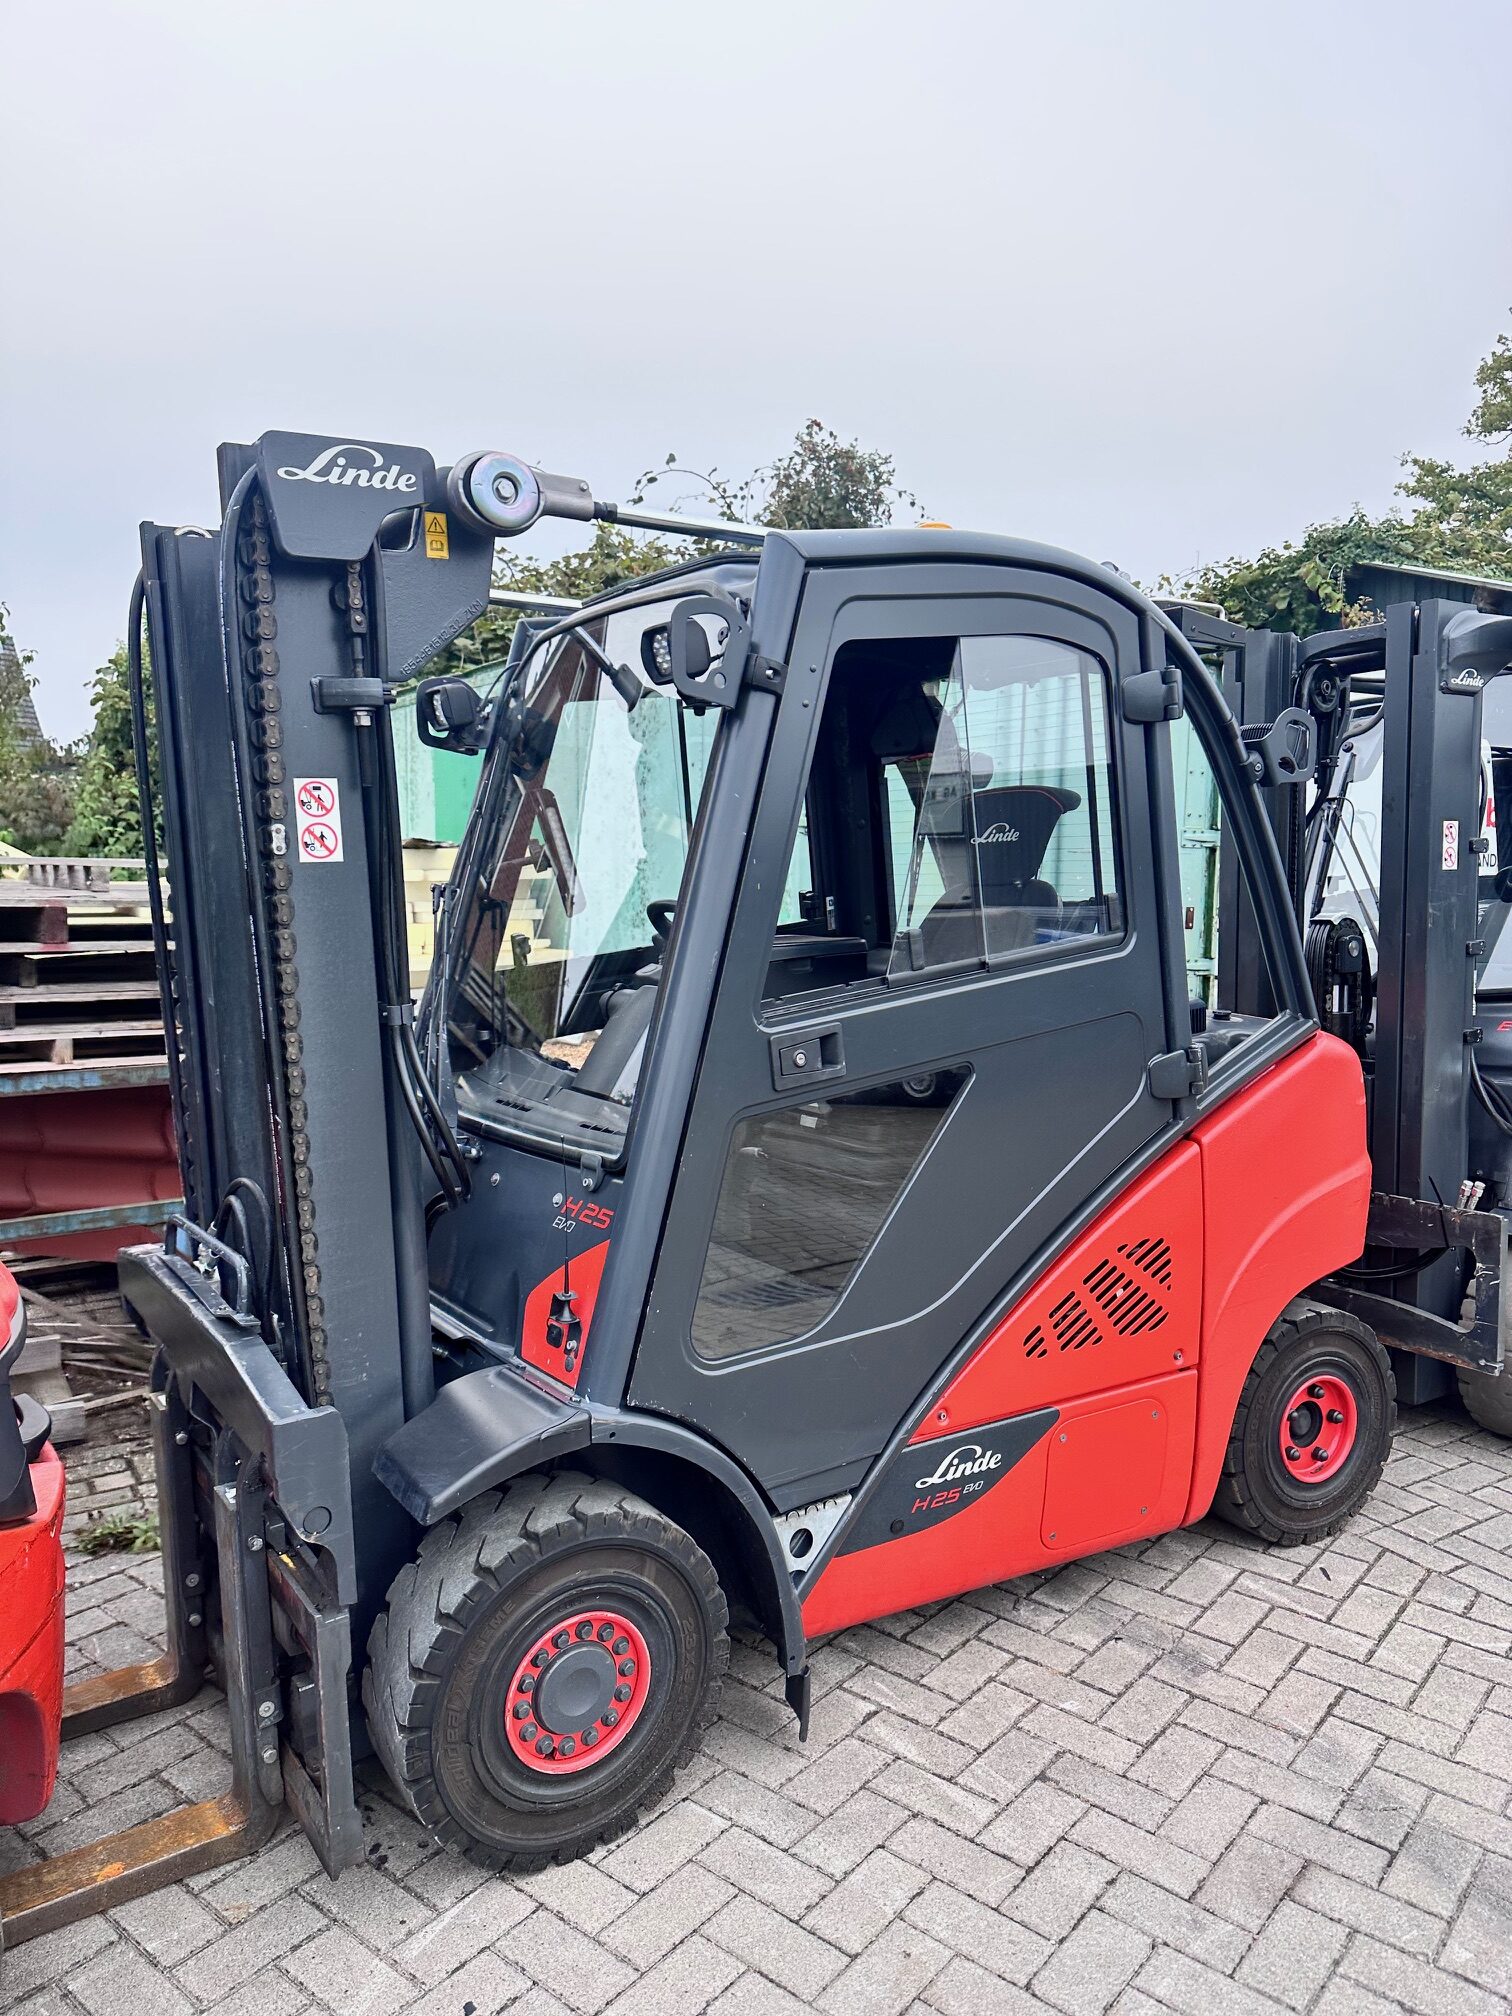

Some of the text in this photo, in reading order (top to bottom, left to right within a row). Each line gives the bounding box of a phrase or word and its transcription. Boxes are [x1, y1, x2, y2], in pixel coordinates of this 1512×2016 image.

[277, 444, 417, 492] Linde
[1451, 668, 1485, 687] Linde
[970, 822, 1020, 844] Linde
[552, 1215, 576, 1233] EVO
[915, 1445, 1002, 1489] Linde
[962, 1480, 984, 1494] EVO
